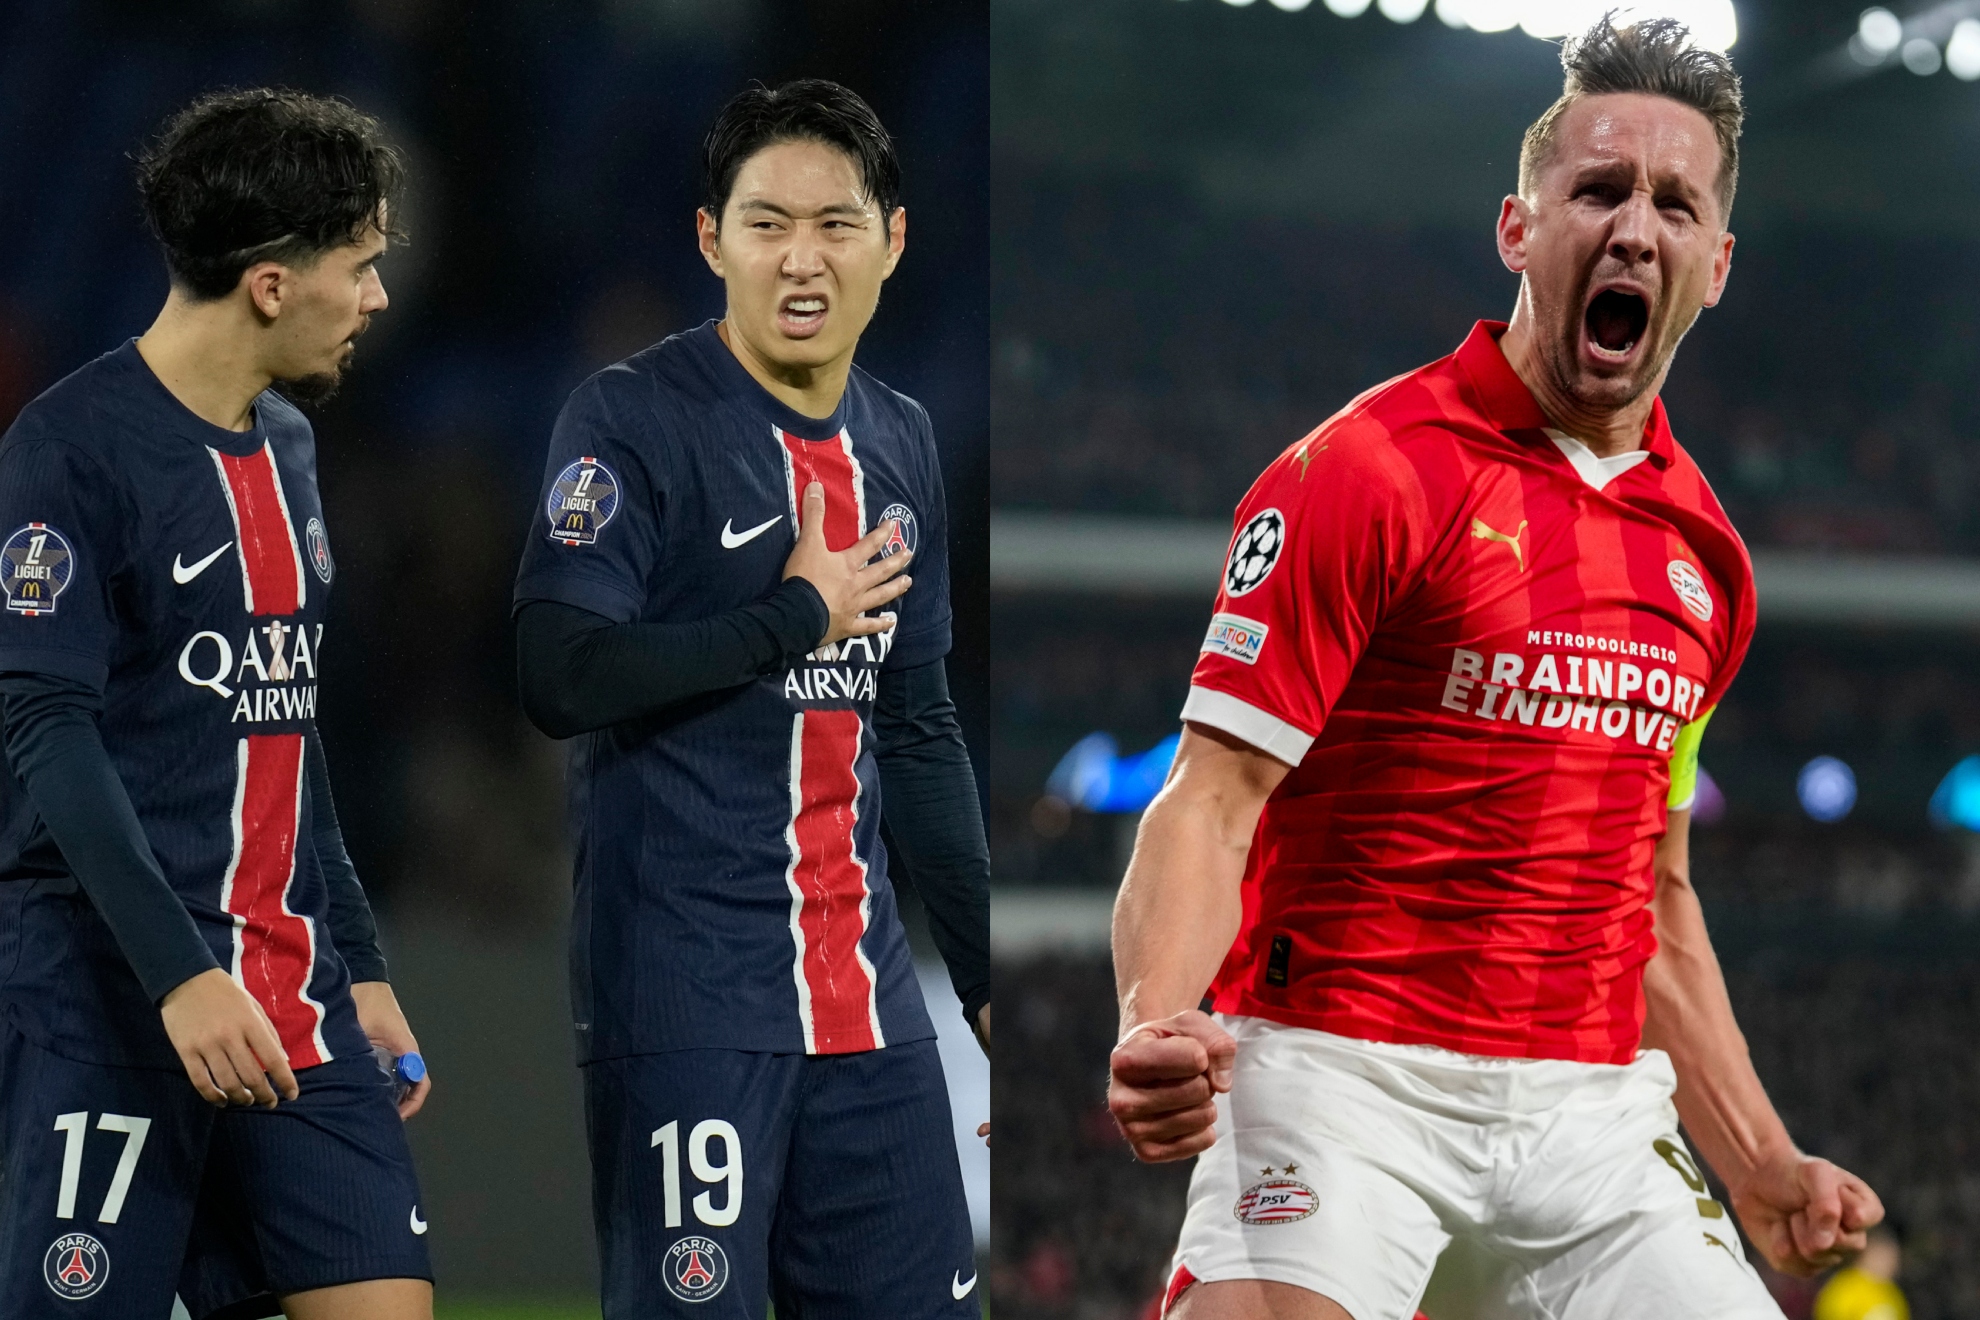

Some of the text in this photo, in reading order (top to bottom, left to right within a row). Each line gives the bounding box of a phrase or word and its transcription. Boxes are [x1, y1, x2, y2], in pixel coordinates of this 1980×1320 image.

[561, 497, 597, 513] LIGUE 1
[884, 507, 911, 524] PARIS
[554, 530, 580, 538] CHAMPION
[14, 565, 52, 580] LIGUE 1
[1683, 580, 1699, 595] PSV
[1527, 630, 1677, 664] METROPOOLREGIO
[784, 667, 879, 702] AIRWA
[1451, 648, 1705, 720] BRAINPORT
[231, 685, 317, 723] AIRWA
[1441, 674, 1684, 752] EINDHOVE
[53, 1111, 152, 1224] 17
[651, 1119, 744, 1228] 19
[1260, 1194, 1291, 1206] PSV
[56, 1236, 100, 1254] PARIS
[672, 1239, 716, 1257] PARIS
